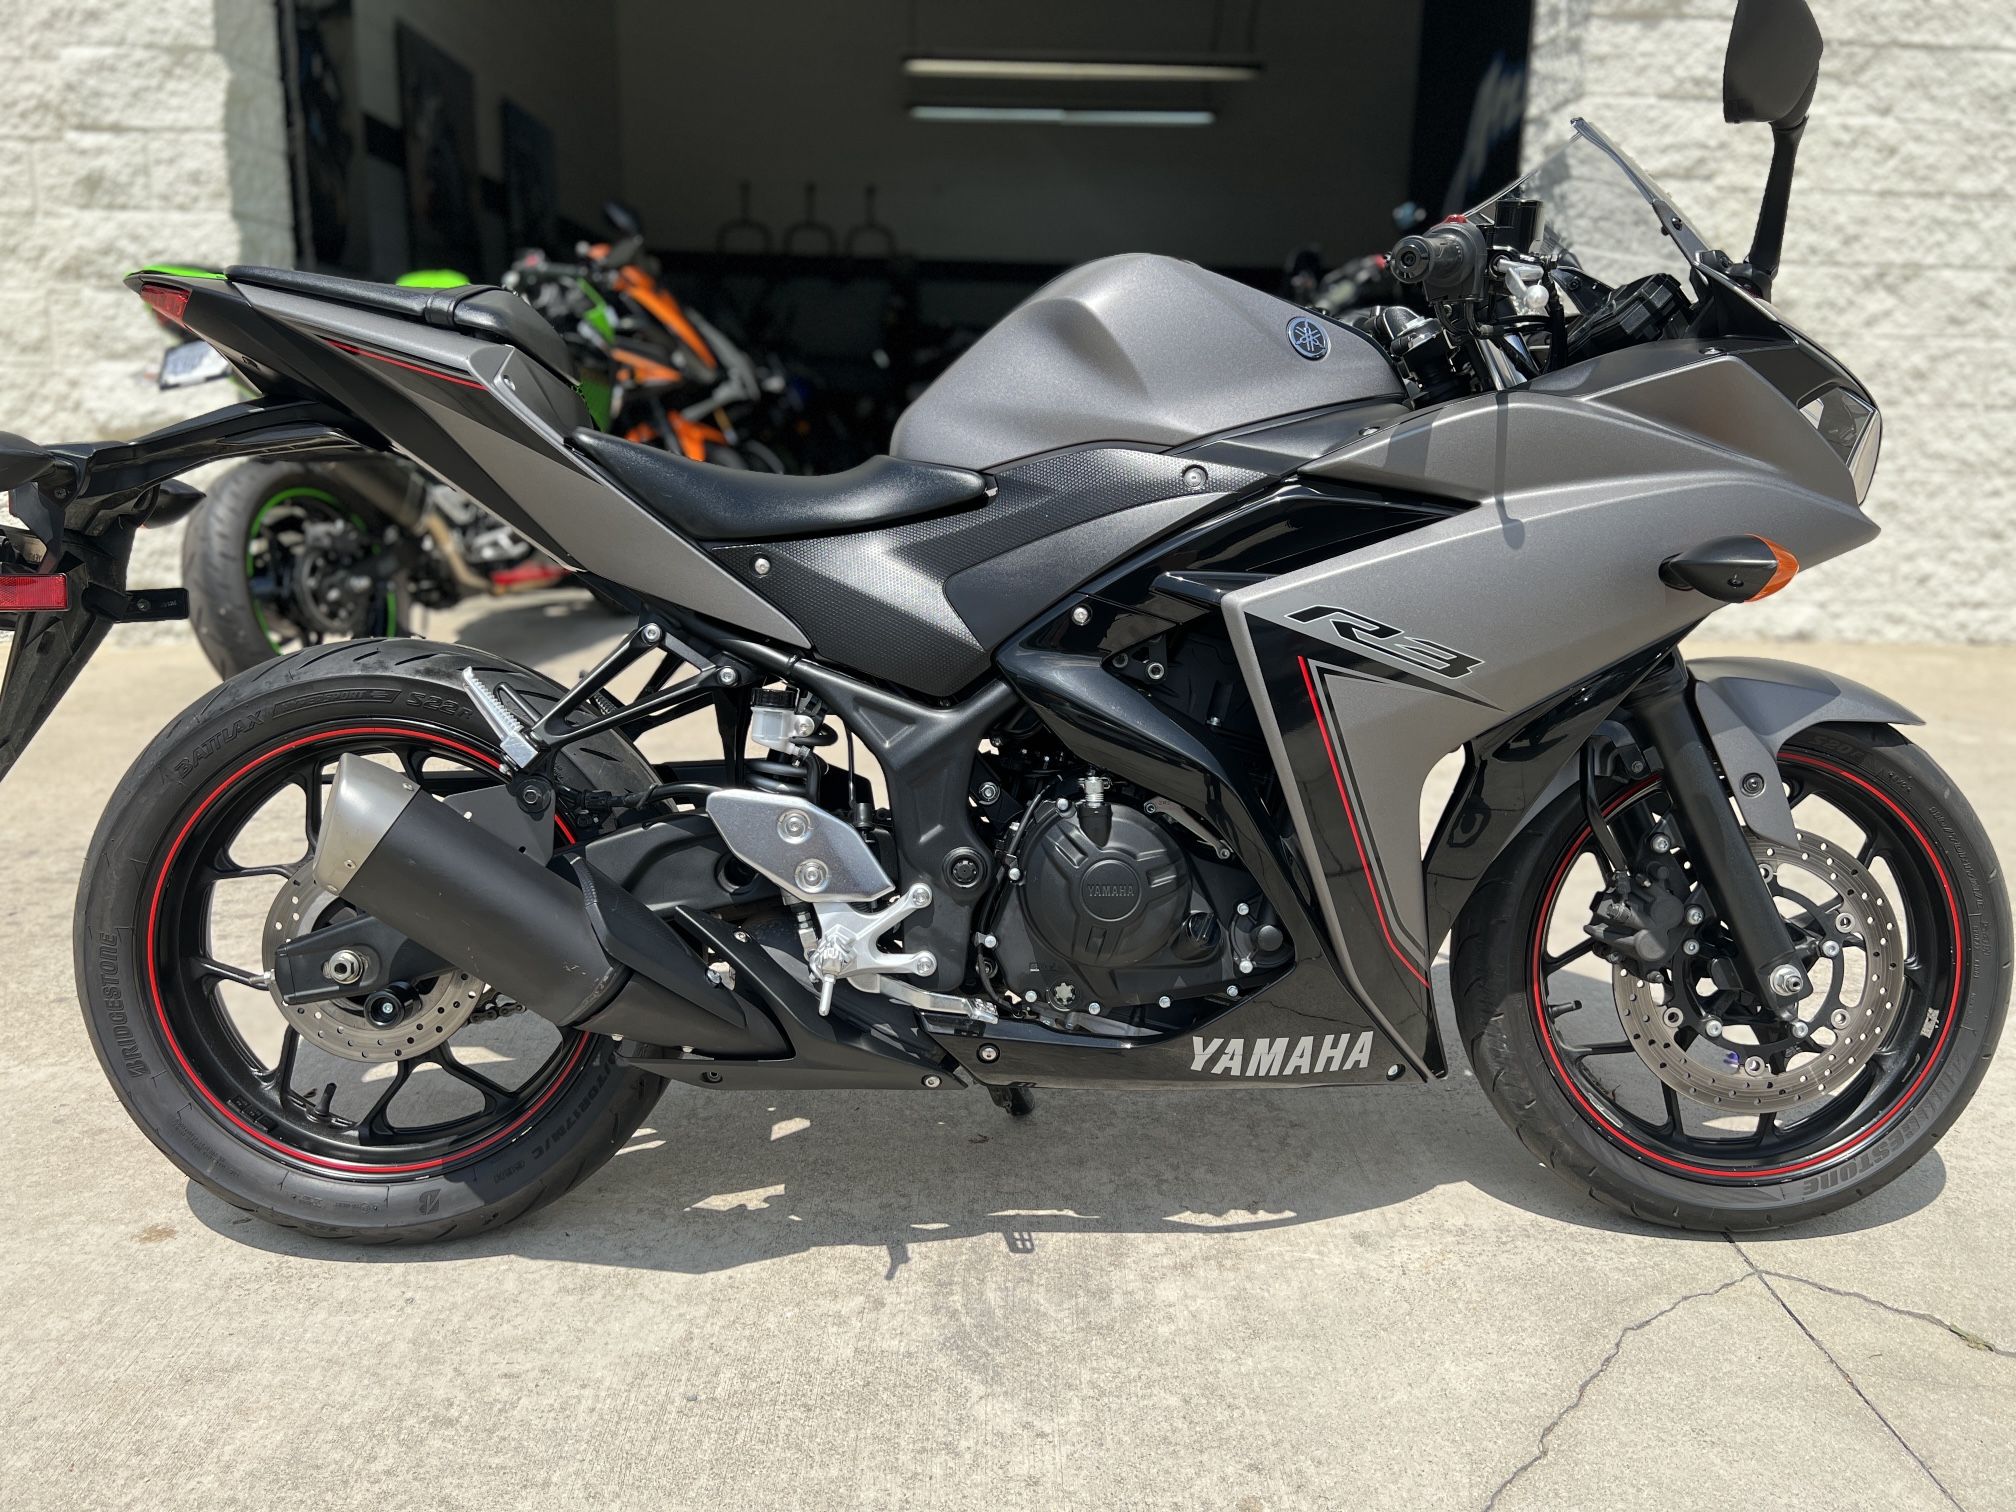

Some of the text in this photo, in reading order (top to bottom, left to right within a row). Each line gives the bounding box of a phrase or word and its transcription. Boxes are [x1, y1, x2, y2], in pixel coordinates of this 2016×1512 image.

[1284, 605, 1485, 679] R3
[174, 709, 265, 781] BATTLAX
[1087, 883, 1134, 898] YAMAHA
[99, 932, 151, 1079] BRIDGESTONE
[1190, 1031, 1374, 1077] YAMAHA
[1803, 1053, 1968, 1195] GESTONE
